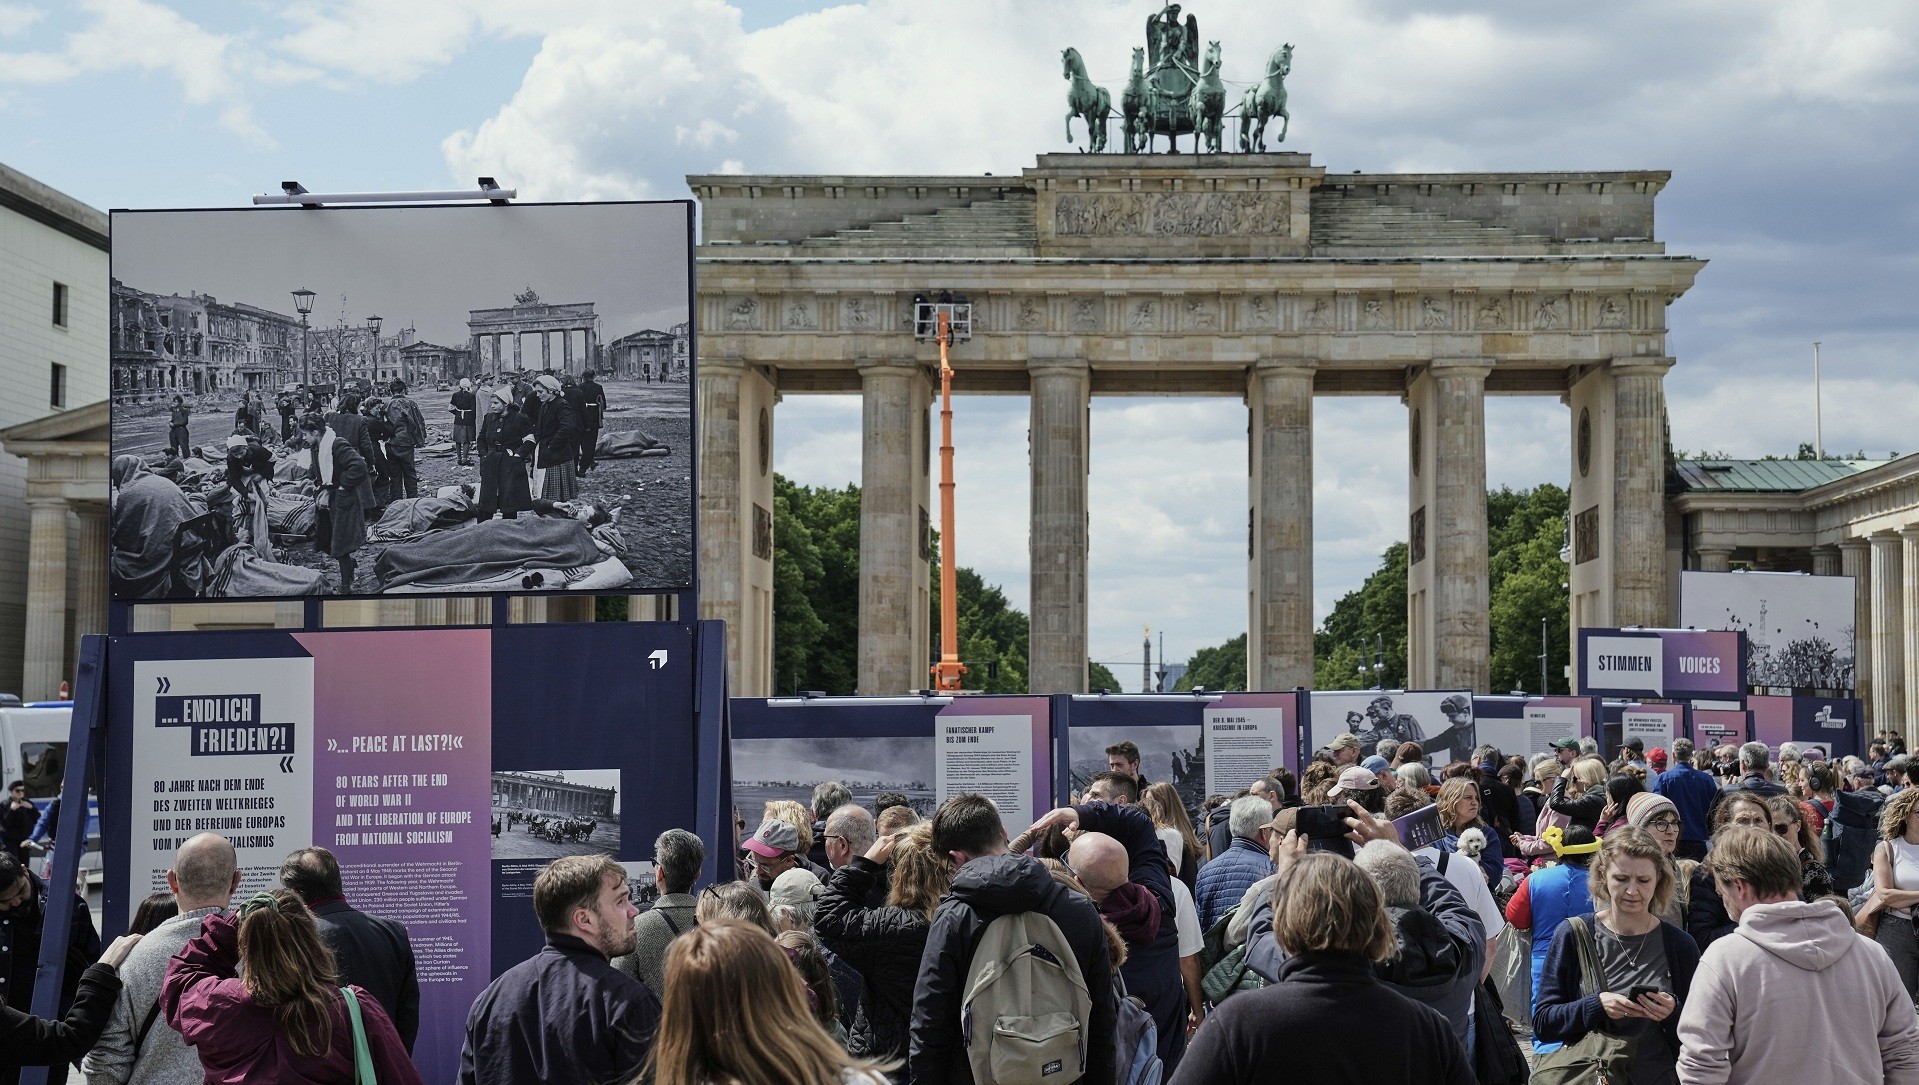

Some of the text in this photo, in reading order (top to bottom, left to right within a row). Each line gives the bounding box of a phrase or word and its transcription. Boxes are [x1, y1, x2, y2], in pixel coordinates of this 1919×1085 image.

[1598, 654, 1652, 672] STIMMEN
[1679, 656, 1720, 674] VOICES
[183, 698, 252, 723] ENDLICH
[199, 726, 286, 752] FRIEDEN?!
[353, 736, 388, 753] PEACE
[392, 735, 406, 752] AT
[154, 778, 265, 793] 80 JAHRE NACH DEM ENDE
[336, 774, 448, 789] 80 YEARS AFTER THE END
[154, 797, 274, 812] DES ZWEITEN WELTKRIEGES
[336, 793, 412, 808] OF WORLD WAR II
[153, 816, 285, 832] UND DER BEFREIUNG EUROPAS
[335, 811, 472, 827] AND THE LIBERATION OF EUROPE
[153, 838, 171, 851] VOM
[335, 830, 453, 846] FROM NATIONAL SOCIALISM
